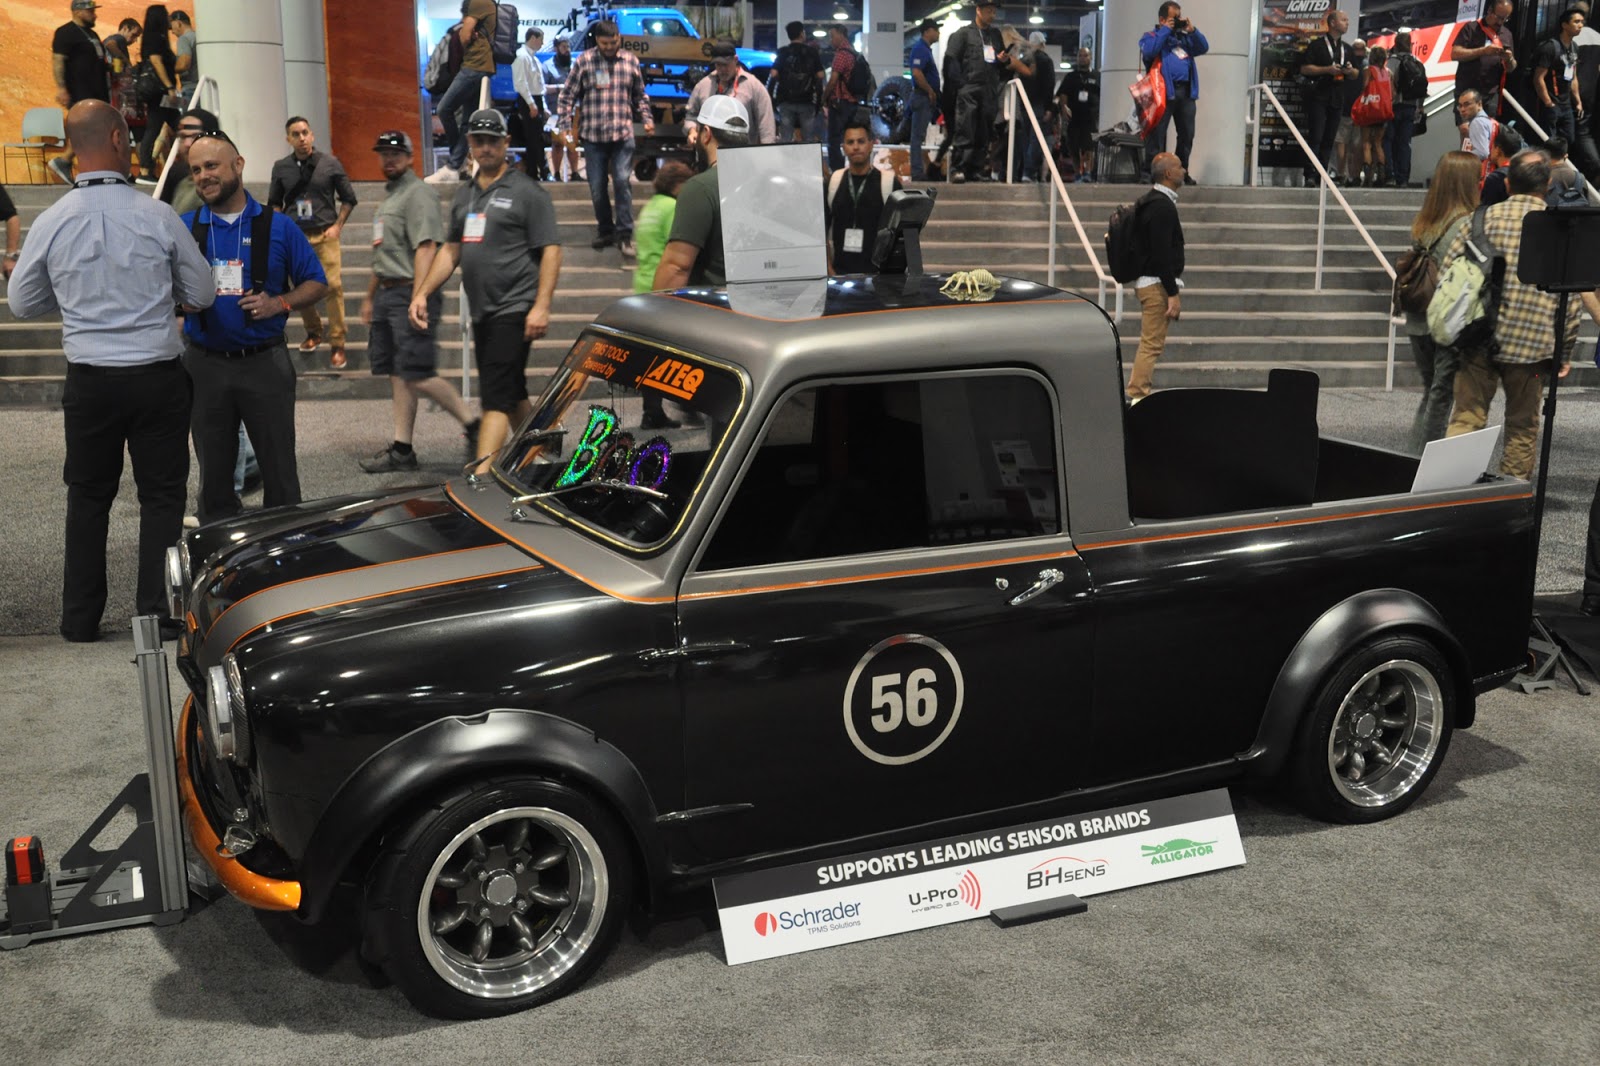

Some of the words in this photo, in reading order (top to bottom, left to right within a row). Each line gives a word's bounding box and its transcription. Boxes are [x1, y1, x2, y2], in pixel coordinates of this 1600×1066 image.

[1286, 0, 1330, 12] IGNITED
[517, 19, 579, 27] REENBA
[606, 345, 630, 364] TOOLS
[582, 356, 609, 375] Powered
[604, 363, 617, 380] by
[647, 358, 705, 393] ATEQ
[553, 405, 673, 494] Boo
[871, 667, 938, 733] 56
[816, 851, 917, 885] SUPPORTS
[920, 835, 1004, 867] LEADING
[1006, 822, 1078, 850] SENSOR
[1079, 808, 1152, 837] BRANDS
[1150, 844, 1214, 866] ALLIGATOR
[908, 888, 958, 906] U-Pro
[778, 901, 862, 930] Schrader
[807, 924, 829, 935] TPMS
[829, 918, 862, 932] Solutions
